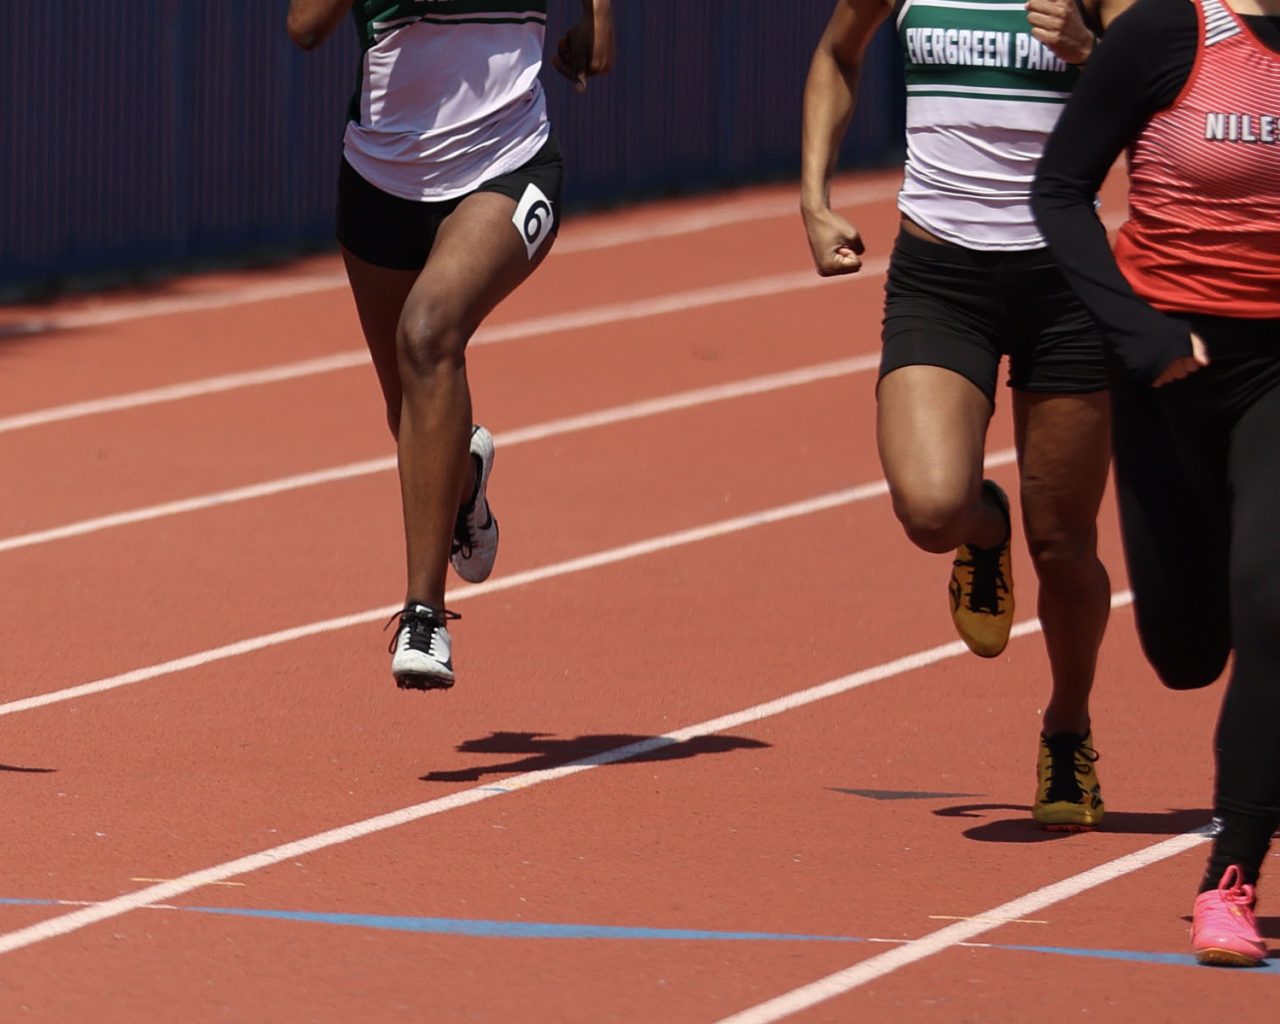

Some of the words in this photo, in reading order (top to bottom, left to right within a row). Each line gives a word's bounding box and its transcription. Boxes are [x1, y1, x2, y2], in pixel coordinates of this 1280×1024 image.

[906, 27, 1011, 67] EVERGREEN
[1205, 112, 1280, 143] NILE
[524, 200, 551, 245] 6
